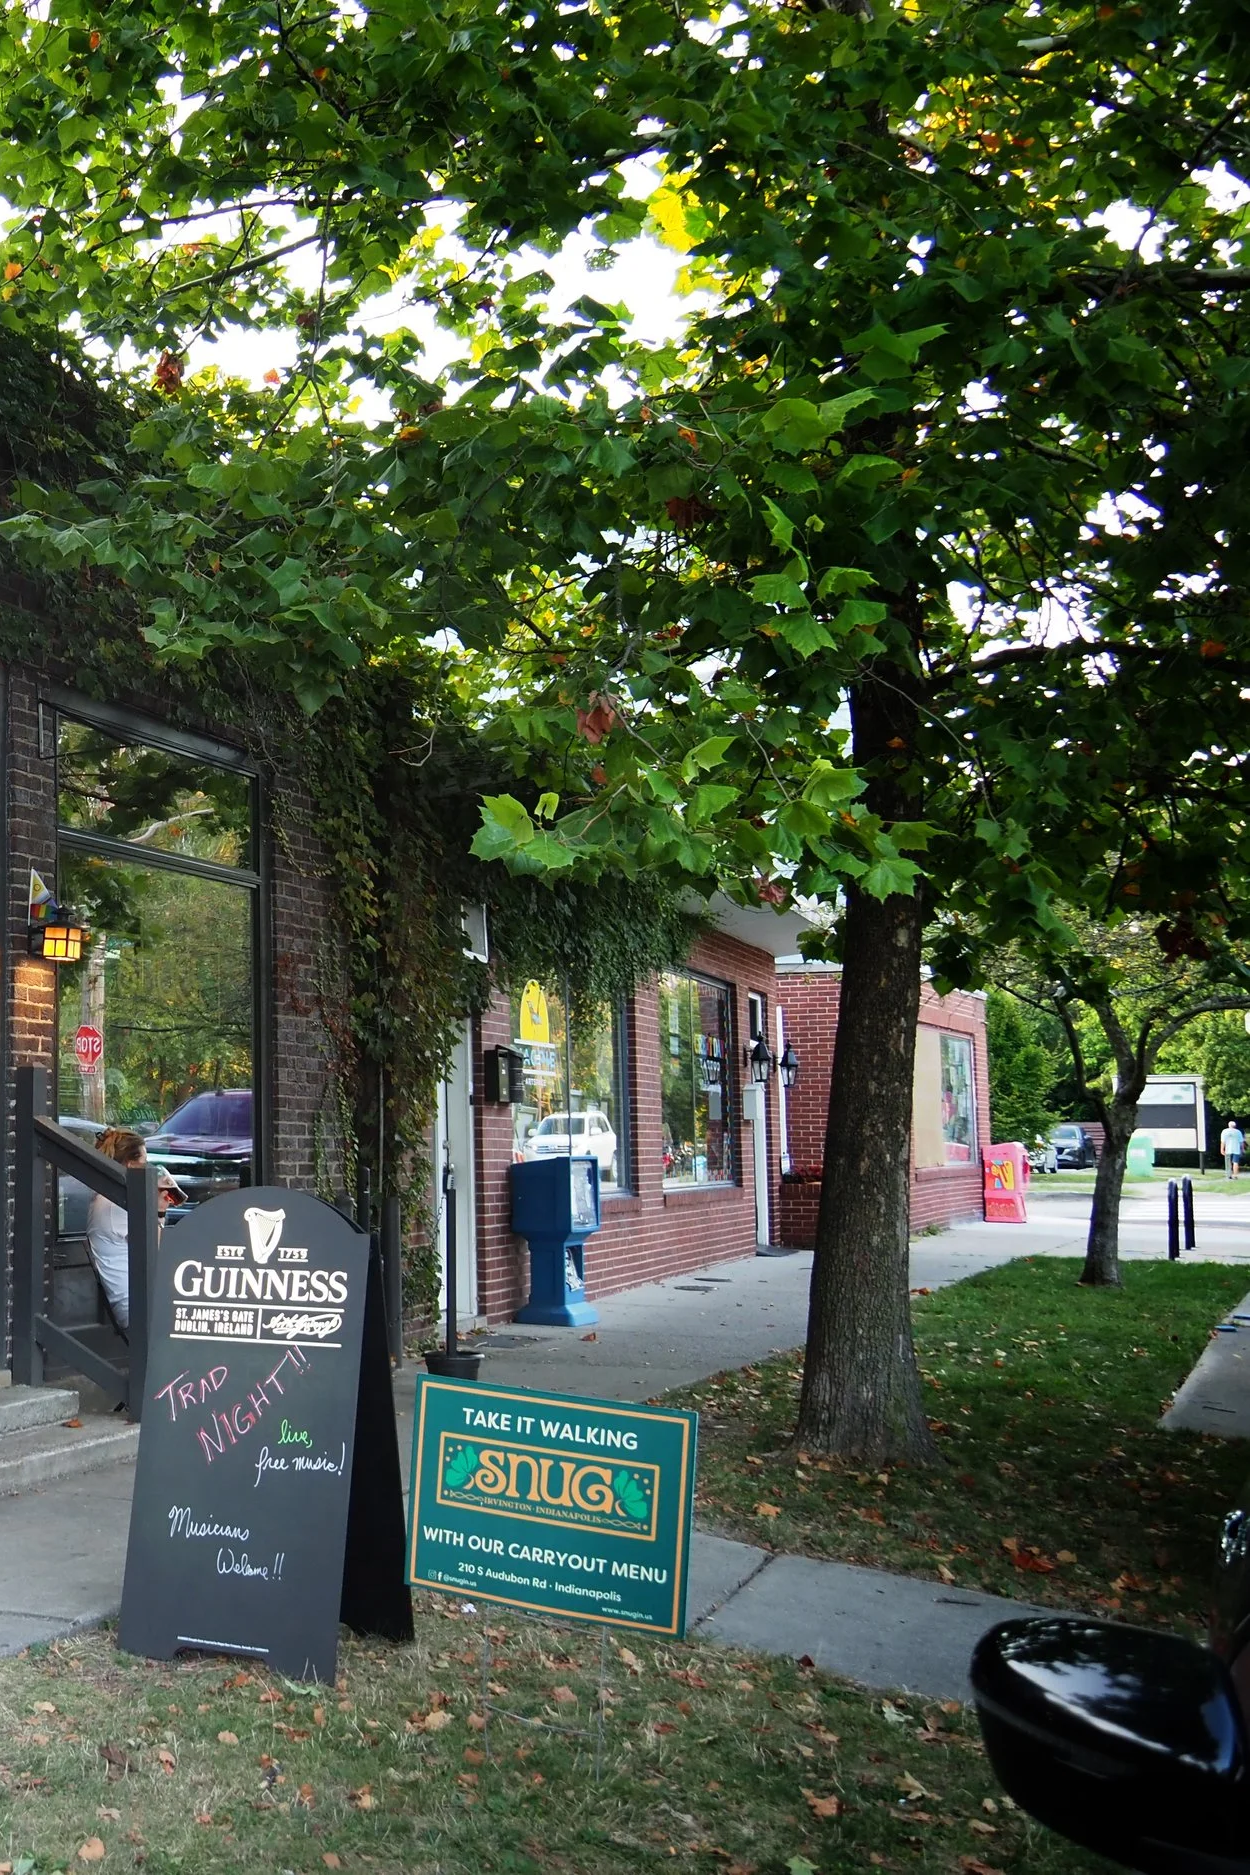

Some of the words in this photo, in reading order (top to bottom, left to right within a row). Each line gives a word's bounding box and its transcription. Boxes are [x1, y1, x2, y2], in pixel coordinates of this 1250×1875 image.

[278, 1249, 308, 1259] 1759
[173, 1260, 348, 1304] GUINNESS
[174, 1319, 211, 1334] DUBLIN,
[213, 1321, 254, 1336] IRELAND
[175, 1307, 188, 1320] ST.
[190, 1308, 230, 1322] JAMES'S
[232, 1310, 255, 1324] GATE
[154, 1366, 229, 1422] TRAD
[462, 1407, 512, 1431] TAKE
[516, 1415, 535, 1434] IT
[540, 1419, 638, 1450] WALKING
[254, 1446, 289, 1488] free
[168, 1505, 250, 1541] Musicians
[483, 1497, 532, 1512] IRVINGTON
[535, 1505, 602, 1524] INDIANAPOLIS
[423, 1525, 464, 1547] WITH
[467, 1534, 504, 1556] OUR
[508, 1543, 607, 1574] CARRYOUT
[611, 1561, 668, 1584] MENU
[458, 1562, 476, 1574] 210
[477, 1565, 484, 1576] S
[485, 1568, 530, 1587] Audubon
[532, 1576, 547, 1589] Rd
[554, 1582, 622, 1603] Indianapolis
